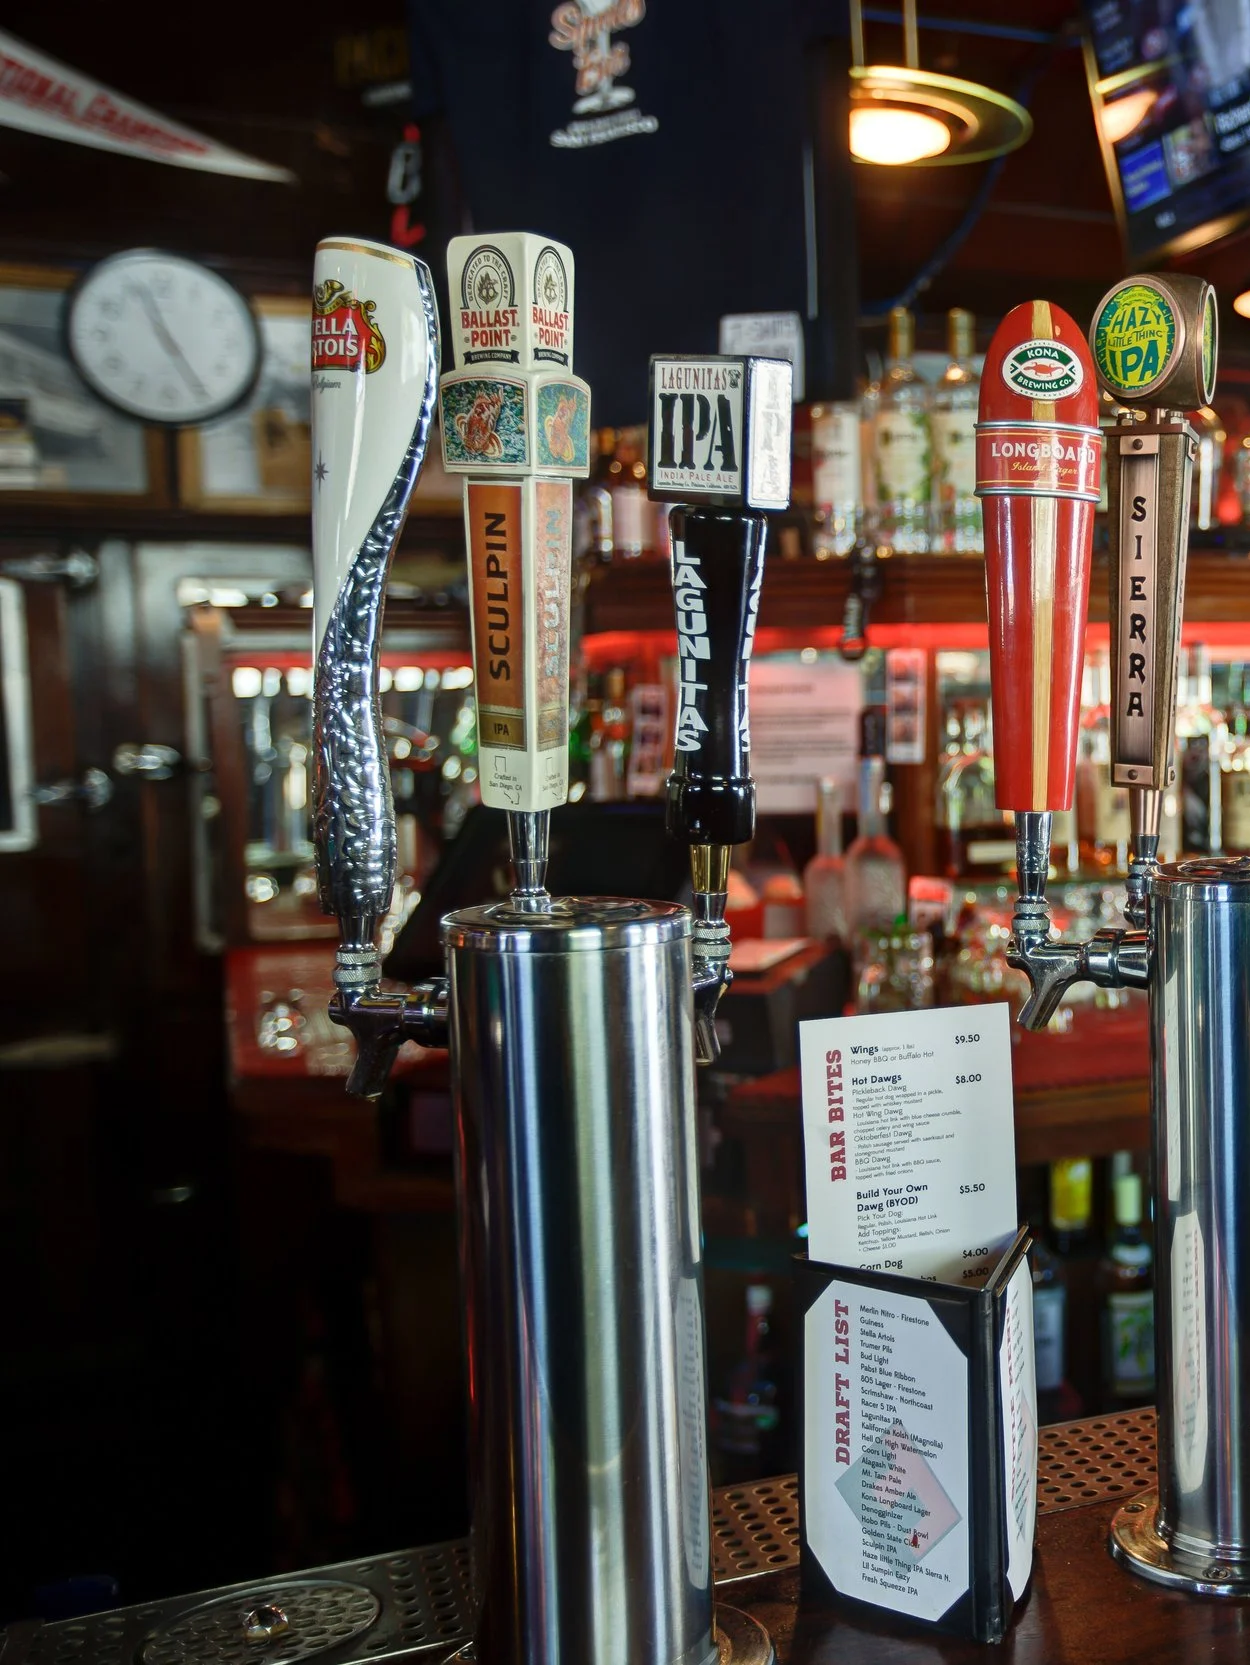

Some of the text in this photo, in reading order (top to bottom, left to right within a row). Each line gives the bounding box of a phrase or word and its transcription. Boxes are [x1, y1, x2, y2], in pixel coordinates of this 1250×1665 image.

[492, 257, 501, 270] THE
[501, 271, 509, 300] CRAFT
[462, 309, 518, 328] BALLAST
[532, 307, 568, 330] BALLAST
[1111, 306, 1161, 334] HAZY
[471, 329, 511, 347] POINT
[539, 328, 564, 349] POINT
[1108, 328, 1163, 347] LITTLE THING
[471, 351, 512, 360] BREWING COMPANY
[1027, 348, 1059, 359] KONA
[1109, 340, 1159, 382] IPA
[662, 367, 727, 390] LAGUNITAS
[1017, 376, 1058, 390] BREWING
[658, 393, 738, 472] IPA
[991, 441, 1095, 464] LONGBOARD
[660, 471, 733, 483] INDIA PALE ALE
[1011, 462, 1078, 475] Island Lager
[484, 511, 510, 681] SCULPIN
[544, 509, 560, 677] SCULPIN
[1126, 495, 1147, 718] SIERRA
[675, 541, 711, 752] LAGUNITAS
[493, 723, 509, 736] IPA
[850, 1034, 980, 1056] Wings $9.50
[852, 1073, 981, 1086] Hot Dawgs $8.00
[852, 1084, 907, 1096] Pickleback Dawg
[826, 1050, 846, 1182] BAR BITES
[853, 1108, 903, 1119] Hot Wing Dawg
[854, 1130, 891, 1142] Oktoberfest
[856, 1183, 985, 1200] Build Your Own $5.50
[857, 1196, 918, 1212] Dawg (BYOD)
[860, 1247, 988, 1270] Corn Dog $4.00
[962, 1267, 989, 1279] $5.00
[860, 1305, 929, 1326] Merlin Nitro Firestone
[860, 1317, 884, 1328] Guiness
[860, 1328, 895, 1342] Stella Artois
[860, 1340, 892, 1353] Trumer Pils
[861, 1352, 889, 1365] Bud Light
[834, 1299, 850, 1466] DRAFT LIST
[861, 1364, 916, 1382] Pabst Blue Ribbon
[861, 1375, 926, 1397] 805 Lager Firestone
[861, 1387, 933, 1410] Scrimshaw Northcoast
[861, 1399, 878, 1408] Racer
[886, 1404, 897, 1413] IPA
[861, 1410, 903, 1426] Lagunitas IPA
[862, 1422, 943, 1450] Kalifornia Kolsh (Magnolia)
[862, 1434, 873, 1442] Hell
[884, 1439, 899, 1450] High
[900, 1443, 937, 1459] Watermelon
[862, 1446, 896, 1461] Coors Light
[862, 1457, 906, 1474] Alagash White
[862, 1481, 916, 1500] Drakes Amber Ale
[862, 1492, 931, 1517] Kona Longboard Lager
[862, 1504, 903, 1520] Denogginizer
[862, 1516, 928, 1539] Hobo Pils Dust Bowl
[862, 1539, 897, 1554] Sculpin IPA
[871, 1564, 893, 1576] Sumpin
[895, 1572, 910, 1583] Eazy
